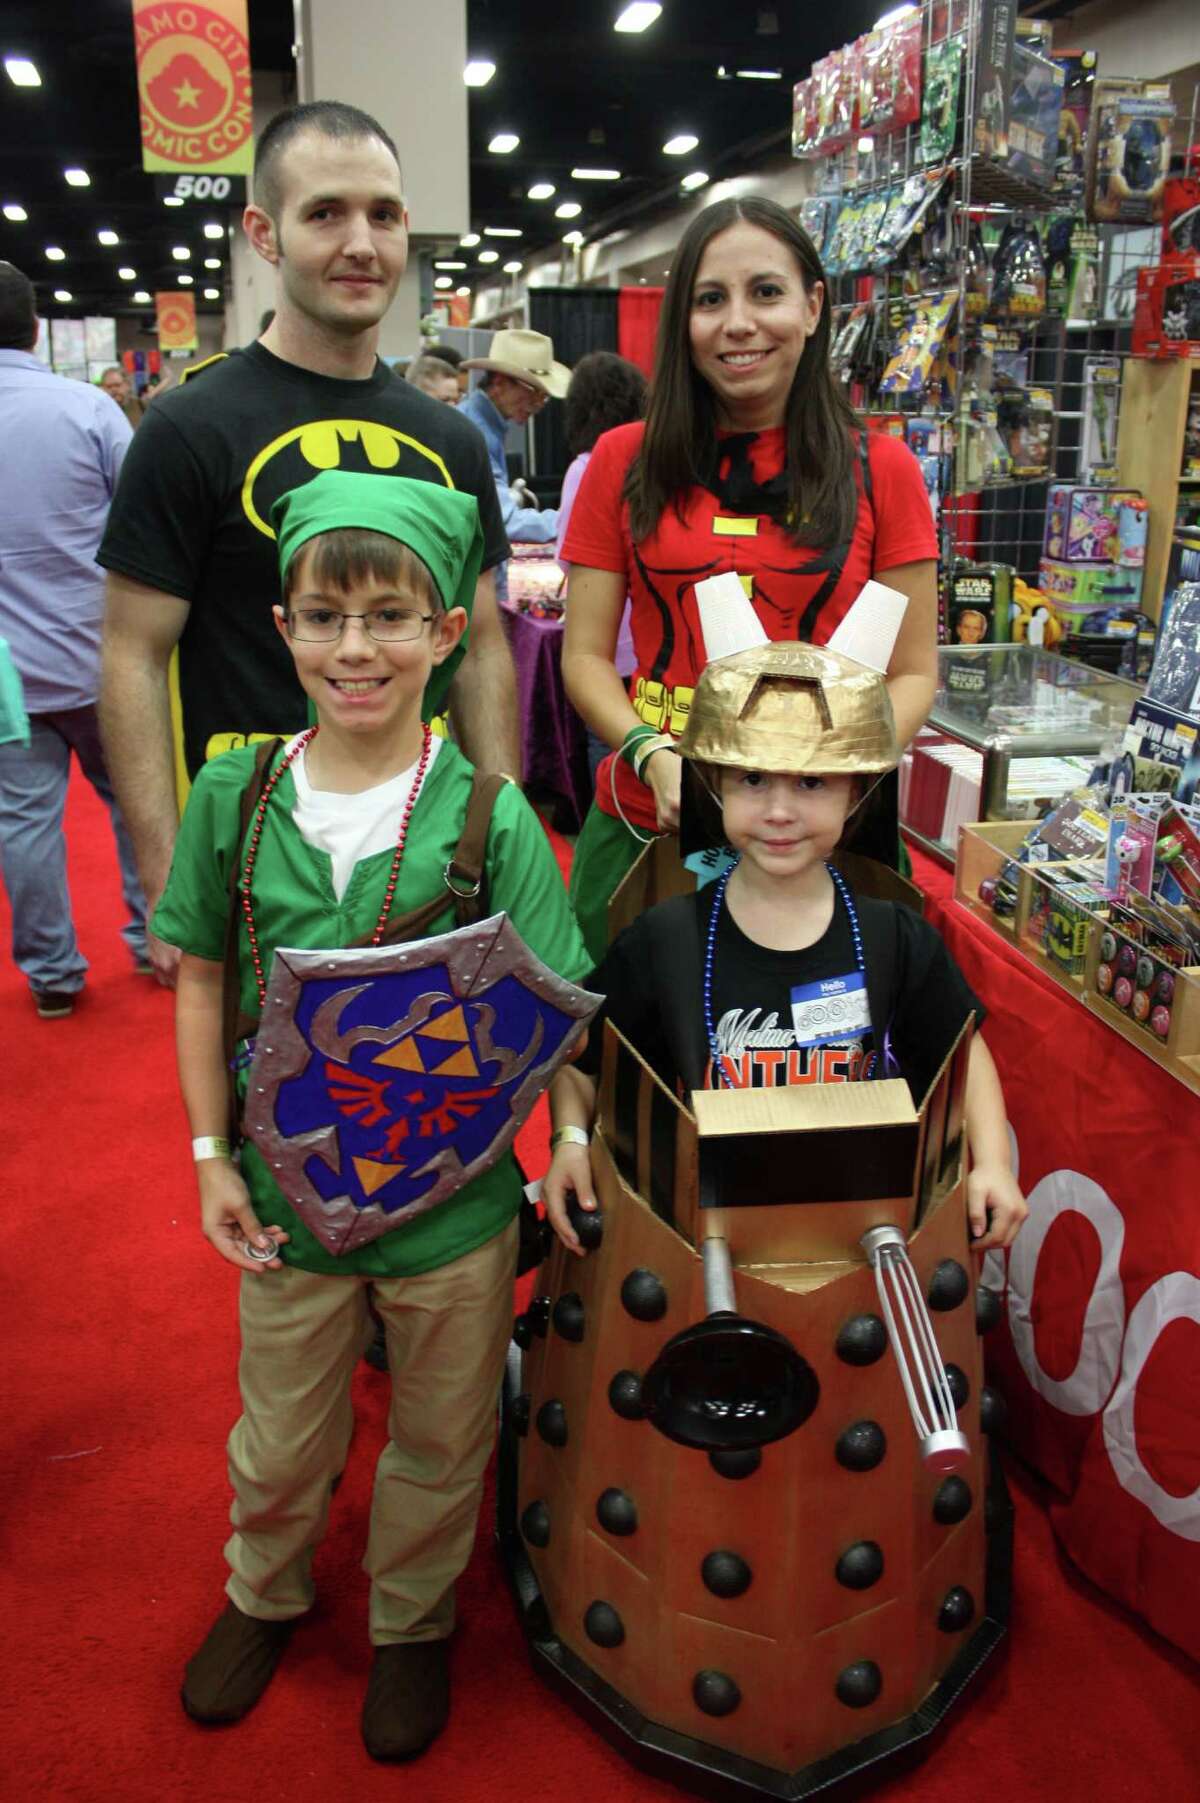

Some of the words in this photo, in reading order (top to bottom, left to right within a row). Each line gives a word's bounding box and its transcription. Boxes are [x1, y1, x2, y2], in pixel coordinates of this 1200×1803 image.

[205, 20, 251, 80] CITY
[207, 100, 252, 153] CON
[174, 175, 231, 199] 500
[955, 584, 992, 597] WARS
[959, 578, 990, 587] STAR
[820, 981, 846, 993] Hello
